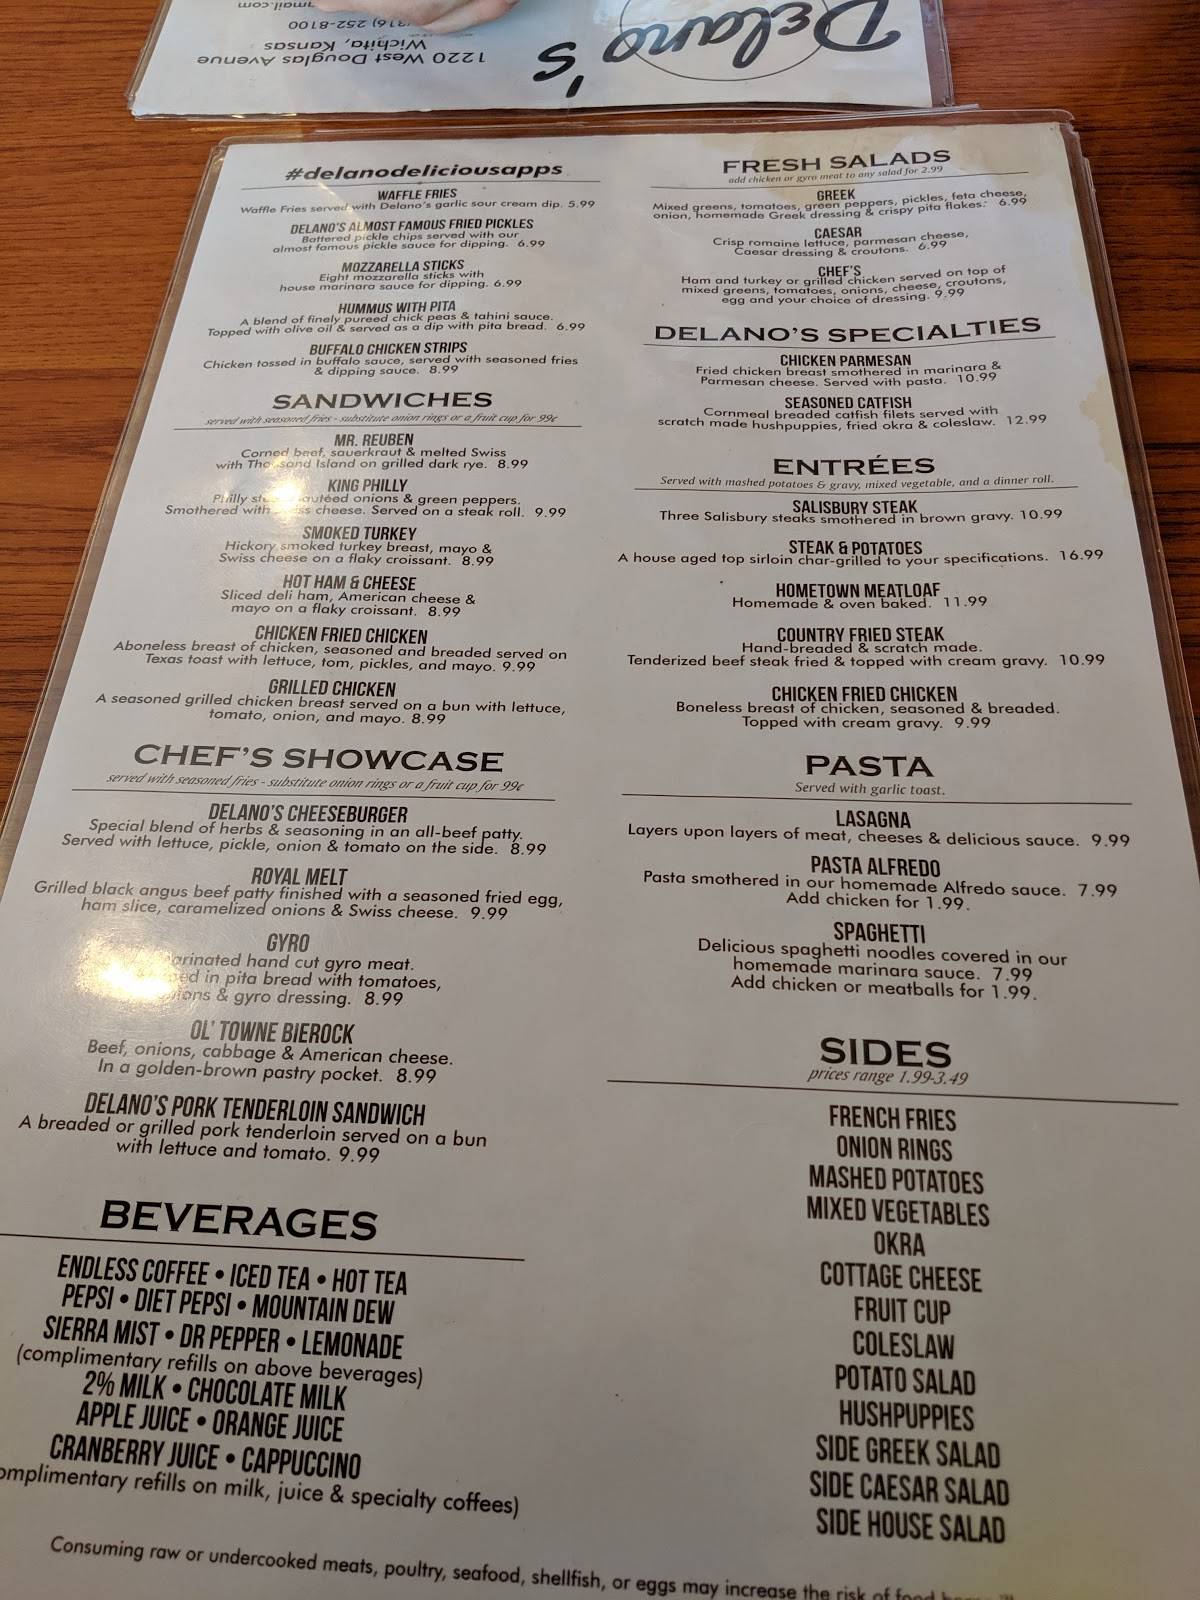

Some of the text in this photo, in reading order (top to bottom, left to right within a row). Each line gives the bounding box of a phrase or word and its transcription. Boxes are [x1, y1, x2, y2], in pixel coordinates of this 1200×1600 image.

[288, 19, 367, 31] 252-8100
[264, 38, 427, 53] Wichita, Kansas
[197, 52, 487, 67] 1220 West Douglas Avenue
[722, 149, 951, 174] FRESH SALADS
[284, 163, 563, 184] #delanodeliciousapps
[375, 188, 458, 202] WAFFLE FRIES
[816, 188, 856, 201] GREEK
[239, 204, 278, 214] Waffle
[279, 203, 308, 213] Fries
[309, 202, 349, 212] served
[350, 201, 377, 211] with
[378, 200, 432, 211] Delano's
[433, 200, 468, 212] garlic
[499, 201, 538, 209] cream
[540, 199, 564, 211] dip.
[567, 199, 596, 208] 5.99
[289, 217, 534, 235] DELANO'S ALMOST FAMOUS FRIED PICKLES
[813, 226, 862, 239] CAESAR
[271, 238, 546, 253] almost famous pickle sauce for dipping. 6.99
[734, 239, 947, 259] Caesar dressing & croutons. 6.99
[340, 258, 465, 273] MOZZARELLA STICKS
[817, 264, 862, 277] CHEF'S
[337, 299, 457, 314] HUMMUS WITH PITA
[654, 316, 1042, 343] DELANO'S SPECIALTIES
[308, 340, 468, 356] BUFFALO CHICKEN STRIPS
[779, 354, 912, 367] CHICKEN PARMESAN
[313, 364, 459, 378] & dipping sauce. 8.99
[271, 391, 494, 410] SANDWICHES
[333, 433, 415, 447] MR. REUBEN
[773, 454, 936, 475] ENTRÉES
[326, 478, 408, 493] KING PHILLY
[792, 500, 918, 515] SALISBURY STEAK
[301, 525, 417, 541] SMOKED TURKEY
[788, 540, 923, 556] STEAK & POTATOES
[281, 574, 417, 592] HOT HAM & CHEESE
[775, 582, 941, 598] HOMETOWN MEATLOAF
[230, 603, 462, 618] mayo on a flaky croissant. 8.99
[732, 596, 988, 610] Homemade & oven baked. 11.99
[253, 625, 428, 645] CHICKEN FRIED CHICKEN
[776, 626, 945, 643] COUNTRY FRIED STEAK
[131, 743, 505, 773] CHEF'S SHOWCASE
[805, 755, 934, 778] PASTA
[794, 781, 946, 798] Served with garlic toast.
[207, 803, 409, 824] DELANO'S CHEESEBURGER
[835, 810, 912, 830] LASAGNA
[810, 856, 941, 878] PASTA ALFREDO
[785, 890, 970, 910] Add chicken for 1.99.
[833, 921, 926, 944] SPAGHETTI
[265, 933, 311, 954] GYRO
[188, 1019, 355, 1045] OL' TOWNE BIEROCK
[819, 1037, 952, 1069] SIDES
[807, 1067, 969, 1086] prices range 1.99-3.49
[82, 1092, 426, 1127] DELANO'S PORK TENDERLOIN SANDWICH
[829, 1105, 957, 1132] FRENCH FRIES
[114, 1137, 380, 1164] with lettuce and tomato. 9.99
[836, 1135, 953, 1162] ONION RINGS
[99, 1199, 379, 1241] BEVERAGES
[806, 1196, 991, 1227] MIXED VEGETABLES
[873, 1230, 926, 1258] OKRA
[55, 1254, 410, 1296] ENDLESS COFFEE ICED TEA HOT TEA
[815, 1507, 1007, 1544] SIDE HOUSE SALAD
[48, 1535, 379, 1580] Consuming raw or undercooked meats,
